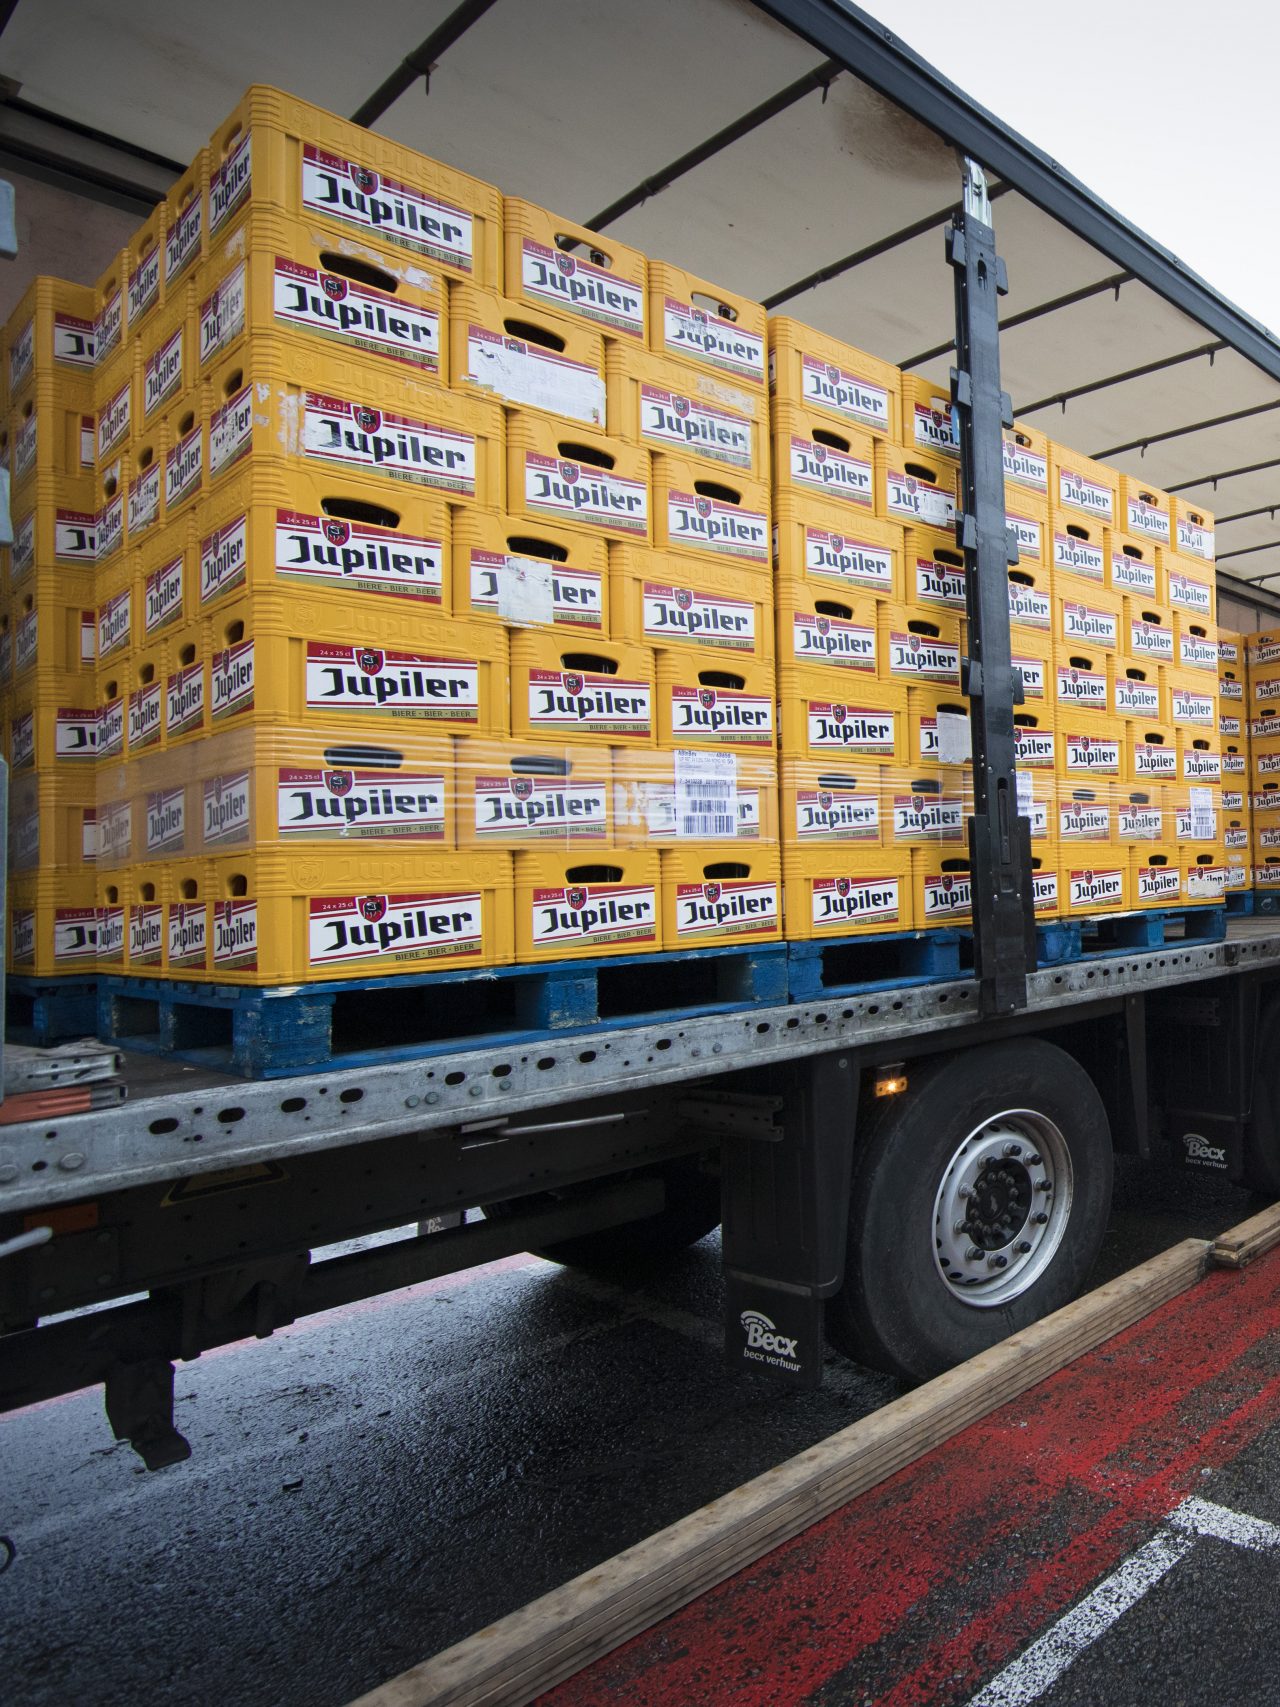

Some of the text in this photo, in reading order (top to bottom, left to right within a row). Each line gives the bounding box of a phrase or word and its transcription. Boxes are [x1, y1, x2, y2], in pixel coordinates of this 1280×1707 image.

[211, 151, 250, 221] Jupiler
[316, 172, 462, 241] Jupiler
[167, 214, 200, 270] Jupiler
[130, 263, 158, 316] Jupiler
[532, 262, 638, 312] Jupiler
[203, 291, 242, 350] Jupiler
[286, 284, 431, 343] Jupiler
[355, 339, 433, 364] BIERE BIER BEER
[148, 350, 181, 404] Jupiler
[811, 374, 882, 412] Jupiler
[101, 397, 129, 447] Jupiler
[651, 407, 746, 446] Jupiler
[320, 420, 465, 469] Jupiler
[168, 436, 200, 491] Jupiler
[798, 454, 868, 486] Jupiler
[1004, 457, 1044, 476] upiler
[389, 471, 467, 489] BIERE BIER BEER
[534, 474, 642, 511] Jupiler
[1066, 483, 1108, 507] Jupiler
[676, 510, 762, 540] Jupiler
[1132, 510, 1167, 530] Jupiler
[204, 537, 243, 590] Jupiler
[286, 536, 434, 575] Jupiler
[814, 546, 886, 575] Jupiler
[1058, 546, 1100, 565] Jupiler
[357, 581, 437, 595] BIERE BIER BEER
[480, 571, 596, 604] Jler
[922, 574, 966, 597] Jupil
[1116, 565, 1152, 584] Jupiler
[149, 576, 180, 620] Jupiler
[1174, 584, 1207, 603] Jupiler
[101, 607, 128, 646] Jupiler
[654, 603, 747, 633] Jupiler
[1069, 616, 1112, 634] Jupiler
[801, 630, 872, 654] Jupiler
[1135, 632, 1170, 648] Jupiler
[1184, 645, 1215, 660] Jupiler
[896, 647, 956, 670] Jupiler
[215, 662, 252, 703] Jupiler
[322, 668, 468, 703] Jupiler
[1062, 680, 1104, 697] Jupiler
[169, 684, 202, 721] Jupiler
[539, 690, 645, 718] Jupiler
[1120, 690, 1156, 706] Jupiler
[1177, 702, 1210, 716] Jupiler
[130, 699, 159, 736] Jupiler
[680, 705, 767, 731] Jupiler
[817, 720, 888, 743] Jupiler
[1072, 749, 1115, 765] Jupiler
[1139, 755, 1174, 770] Jupiler
[1187, 761, 1218, 776] Jupiler
[1224, 760, 1243, 769] Jupiler
[207, 793, 245, 833] Jupiler
[290, 790, 438, 824] Jupiler
[484, 794, 600, 826] Jupiler
[804, 805, 875, 828] Jupiler
[900, 808, 959, 831] Jupiler
[150, 806, 182, 842] Jupiler
[360, 824, 440, 836] BIERE BIER BEER
[1064, 813, 1107, 830] Jupiler
[338, 858, 462, 885] Jupiler
[1142, 876, 1177, 894] Jupiler
[820, 890, 893, 916] Jupiler
[1076, 880, 1118, 899] Jupiler
[542, 902, 650, 933] Jupiler
[685, 897, 772, 925] Jupiler
[131, 923, 160, 954] Jupiler
[217, 918, 255, 956] Jupiler
[324, 909, 472, 951] Jupiler
[395, 943, 474, 961] BIERE BIER BEER
[1185, 1156, 1229, 1169] becx verhuur
[1188, 1141, 1226, 1161] Becx
[747, 1323, 798, 1358] Becx
[743, 1347, 801, 1372] becx verhuur
